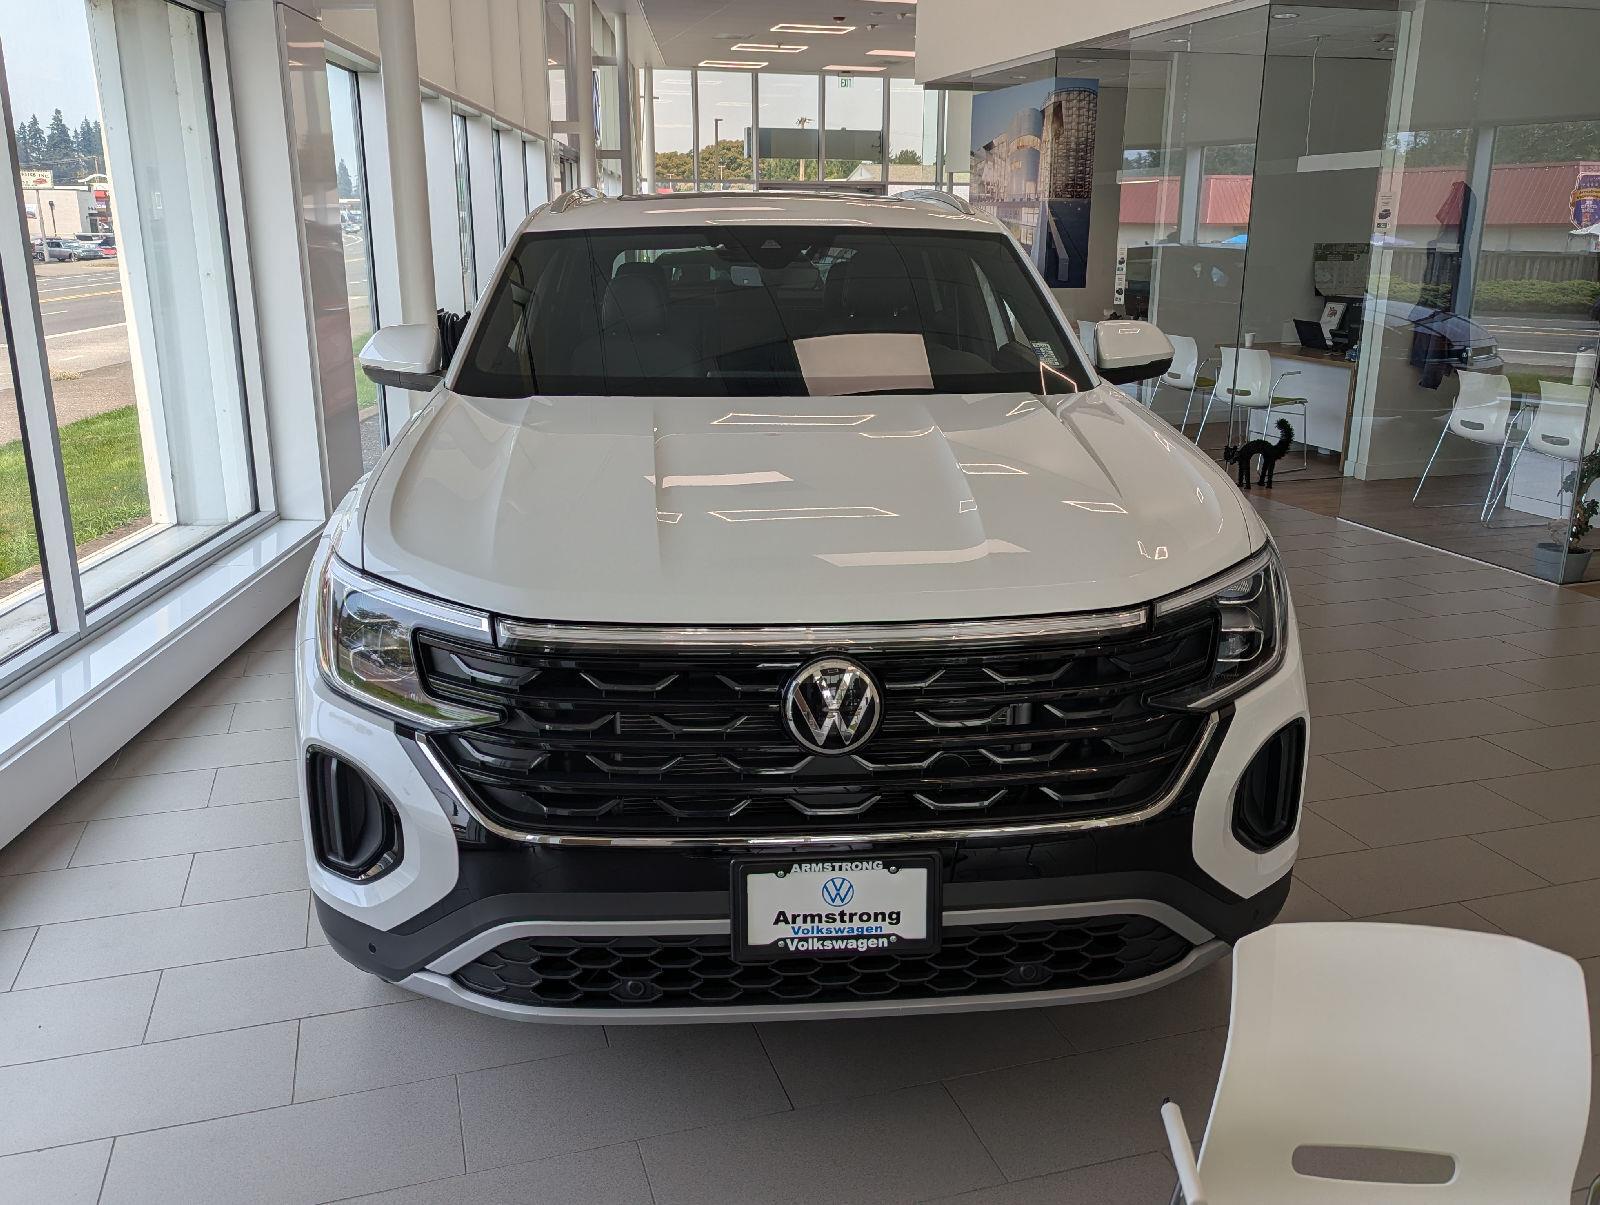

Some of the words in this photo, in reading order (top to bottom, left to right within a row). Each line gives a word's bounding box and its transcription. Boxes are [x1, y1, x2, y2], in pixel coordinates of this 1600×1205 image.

[791, 860, 884, 873] ARMSTRONG
[773, 909, 901, 926] Armstrong
[791, 925, 883, 936] Volkswagen
[786, 936, 888, 951] Volkswagen
